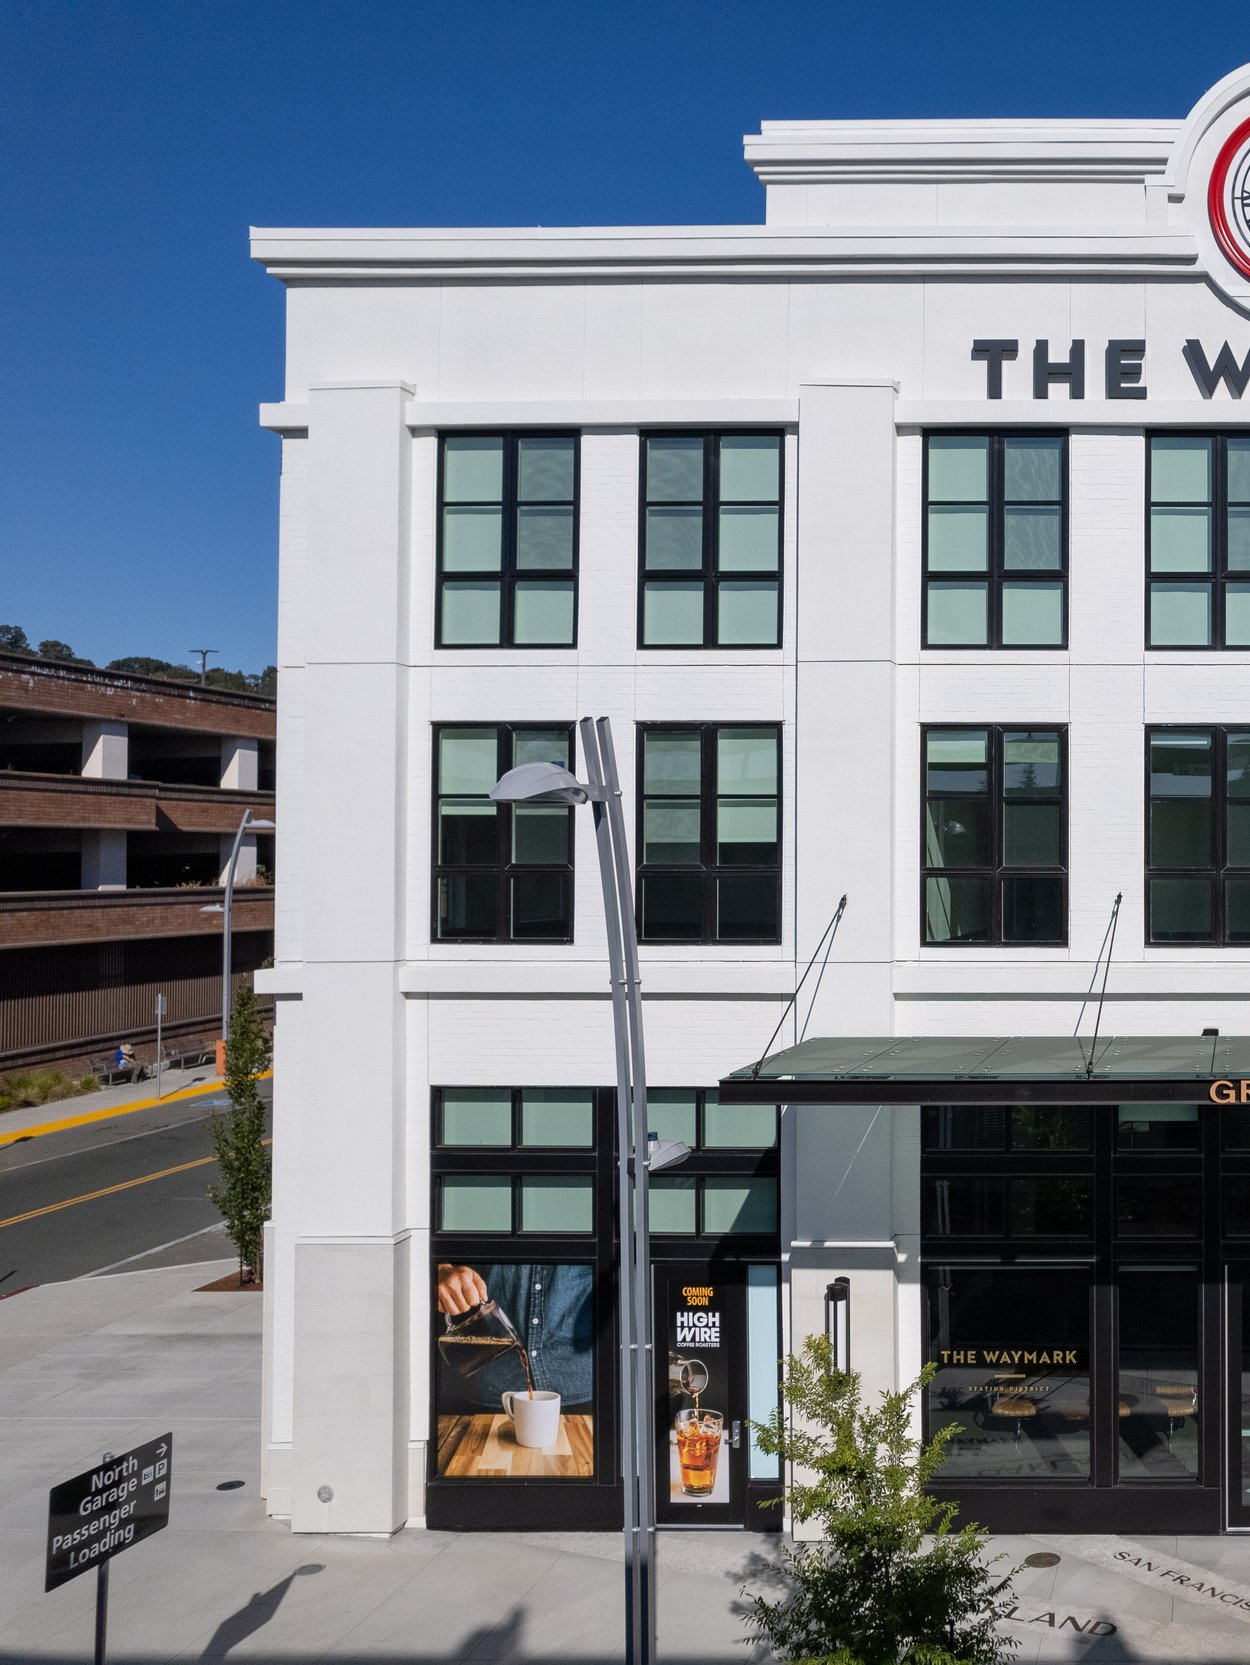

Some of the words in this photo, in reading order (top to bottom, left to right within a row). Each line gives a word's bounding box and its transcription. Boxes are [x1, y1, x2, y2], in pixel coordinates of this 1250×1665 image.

[971, 339, 1148, 401] THE
[682, 1287, 714, 1297] COMING
[686, 1296, 709, 1306] SOON
[676, 1311, 720, 1327] HIGH
[676, 1327, 720, 1342] WIRE
[940, 1350, 977, 1364] THE
[982, 1350, 1078, 1364] WAYMARK
[91, 1456, 138, 1492] North
[79, 1477, 138, 1516] Garage
[52, 1500, 137, 1555] Passenger
[69, 1523, 135, 1569] Loading
[1113, 1551, 1161, 1573] SAN
